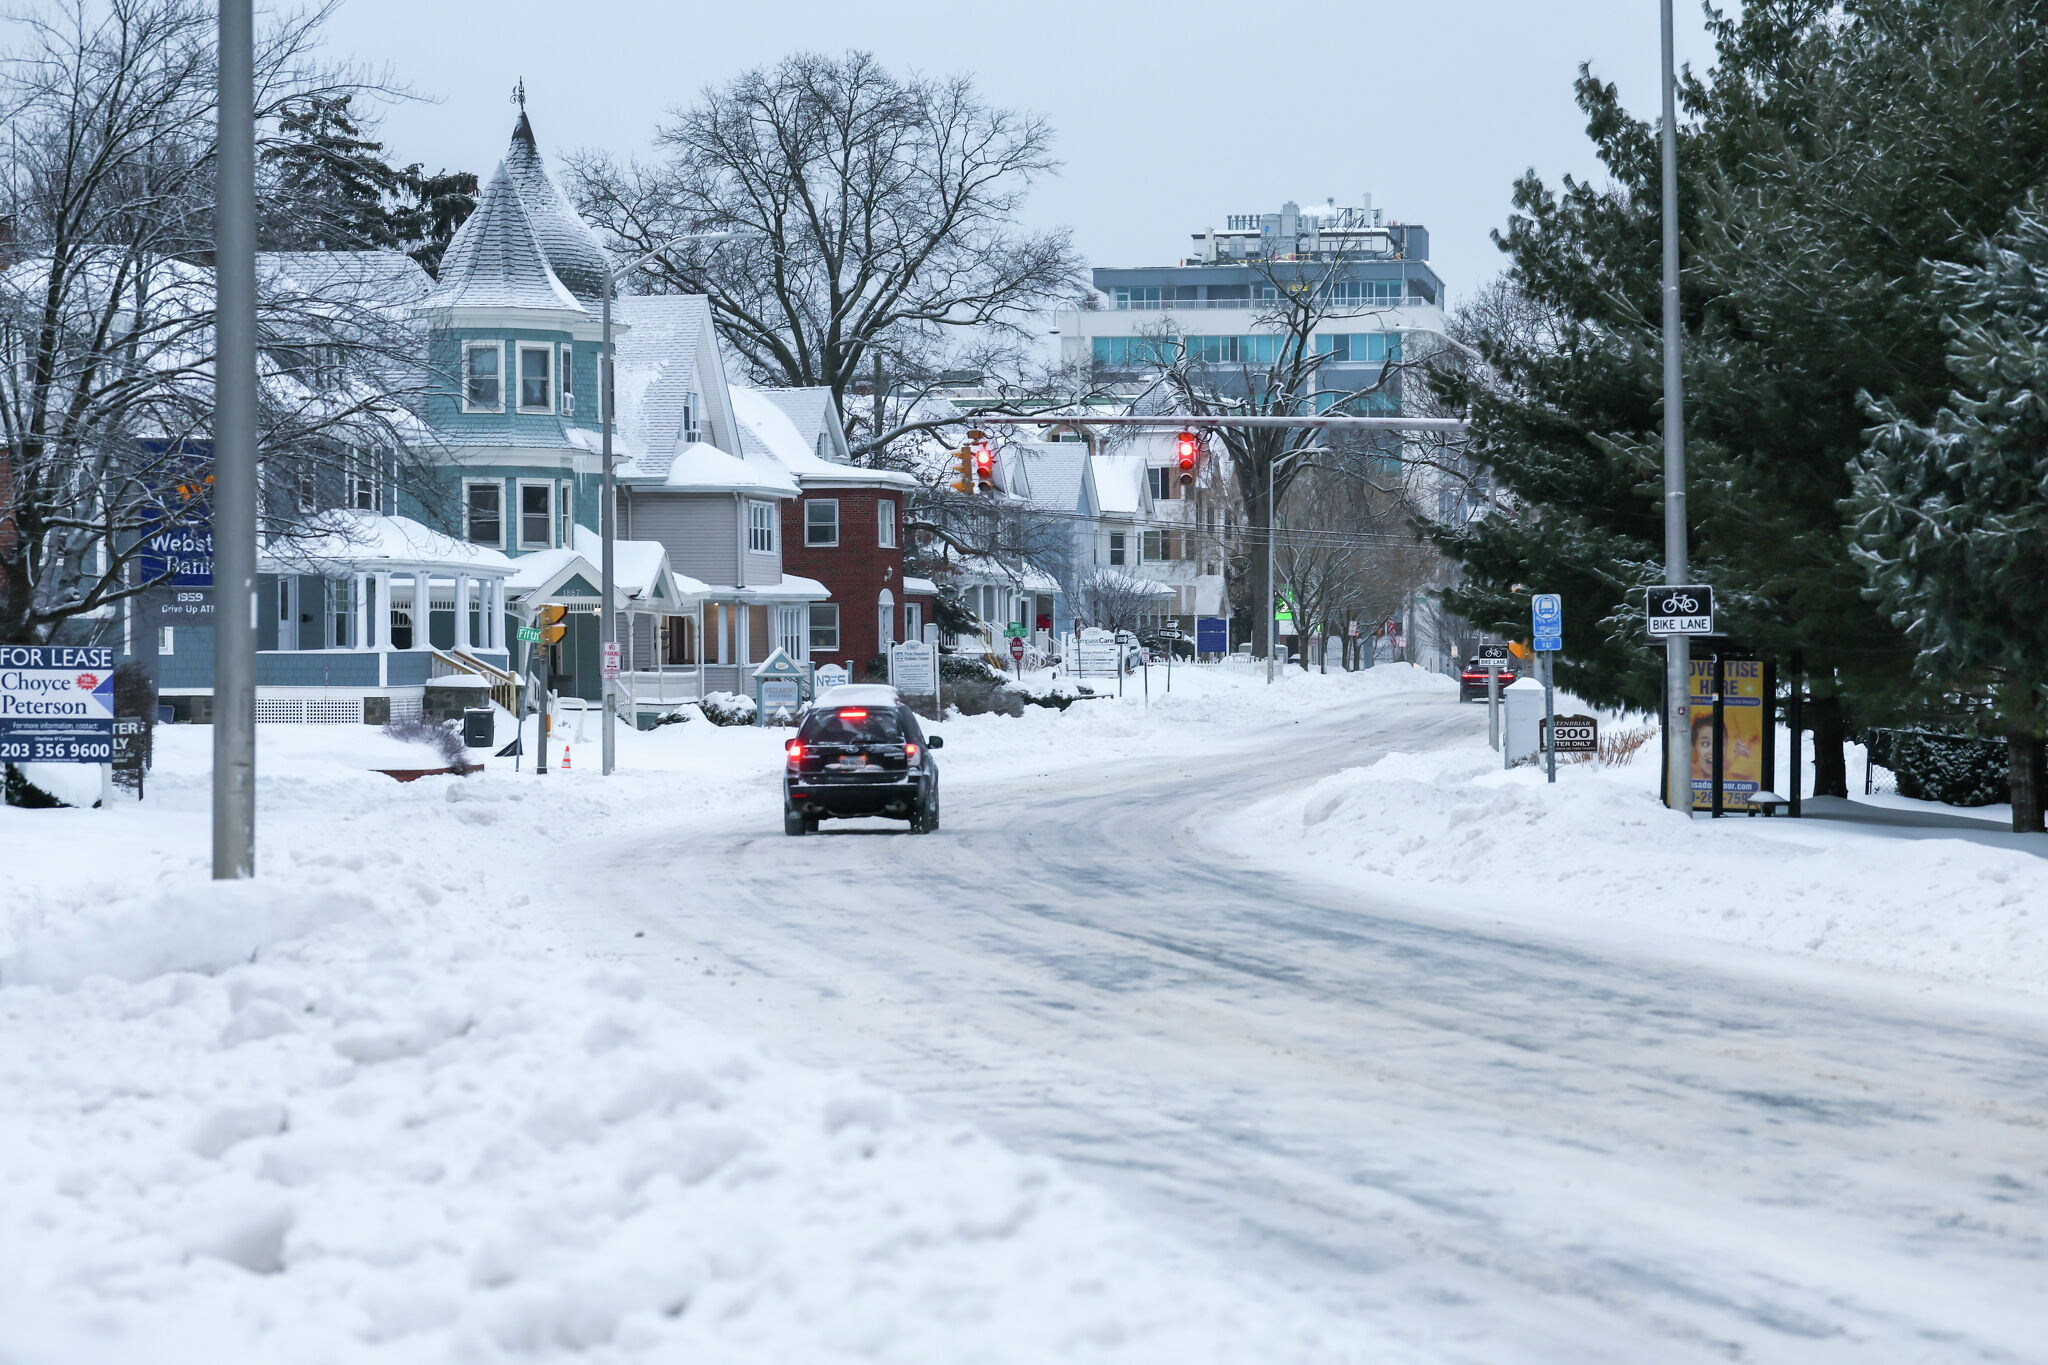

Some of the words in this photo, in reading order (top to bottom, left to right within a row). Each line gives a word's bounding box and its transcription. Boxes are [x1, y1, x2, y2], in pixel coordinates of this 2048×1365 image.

[177, 592, 204, 602] 1959
[186, 604, 198, 614] Up
[1653, 619, 1675, 630] BIKE
[1680, 618, 1707, 630] LANE
[518, 628, 540, 641] Fifth
[0, 647, 44, 667] FOR
[51, 648, 112, 667] LEASE
[2, 671, 71, 696] Choyce
[2, 695, 87, 714] Peterson
[0, 743, 30, 758] 203
[35, 743, 65, 758] 356
[70, 743, 110, 758] 9600
